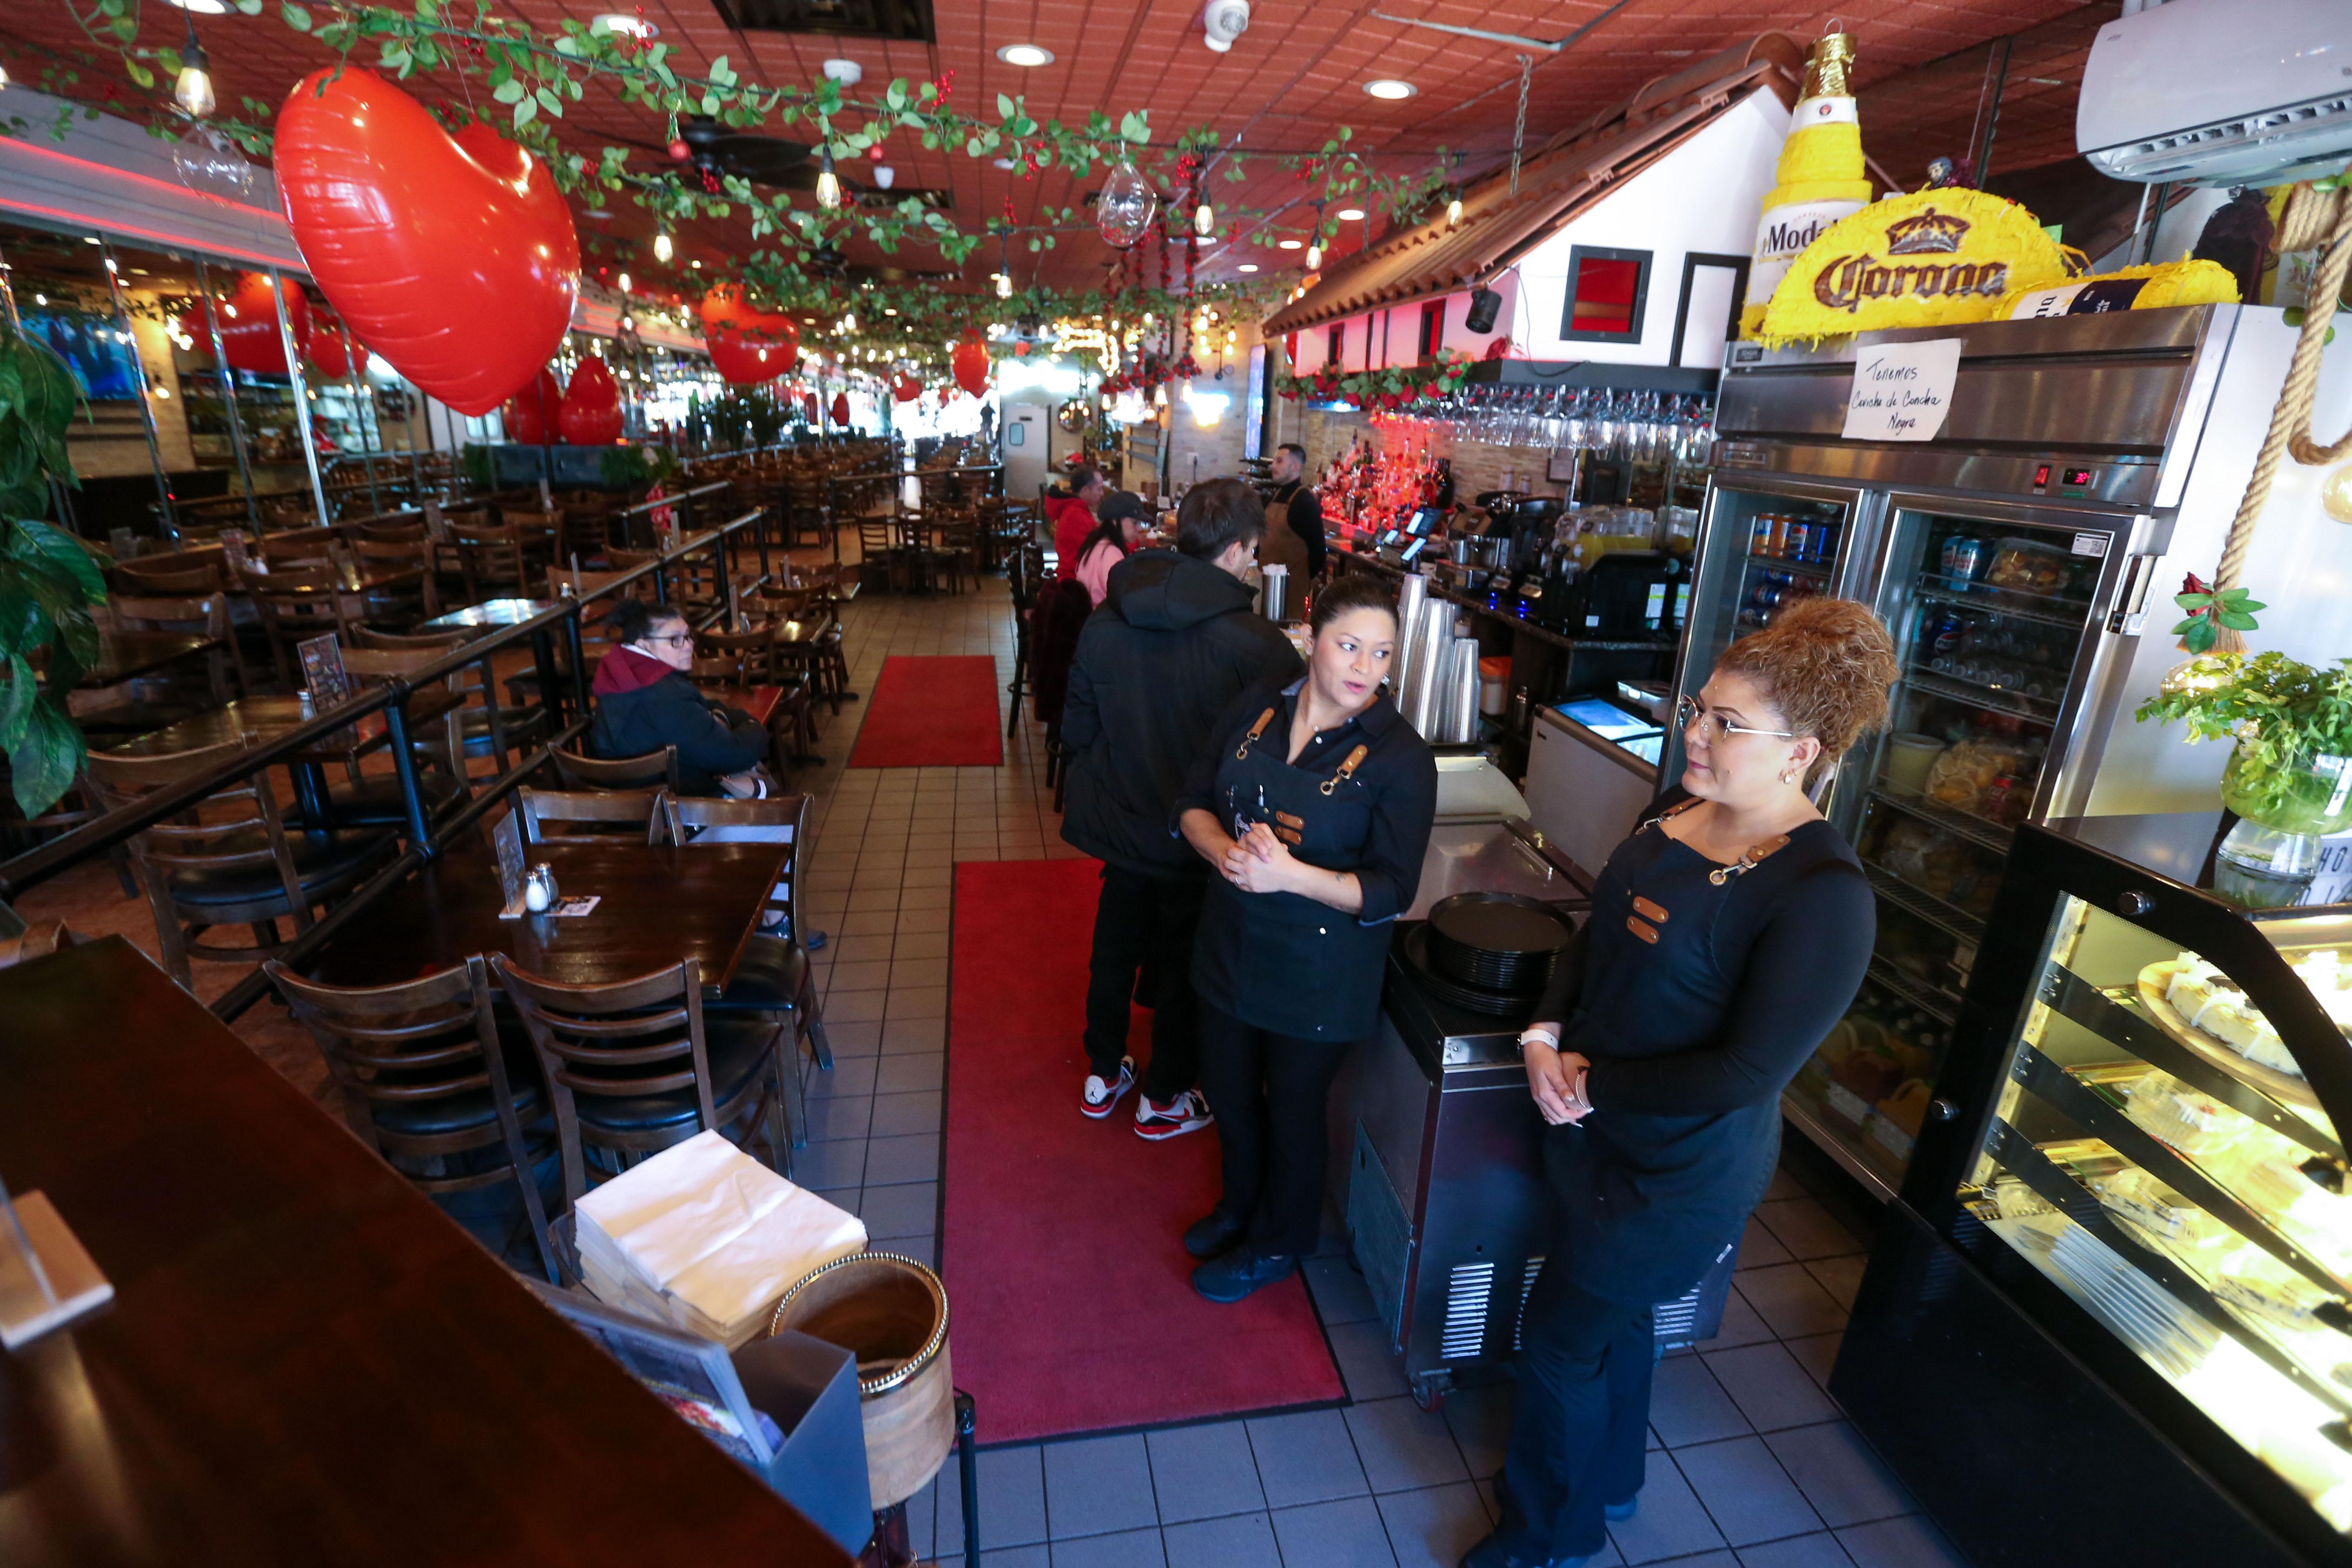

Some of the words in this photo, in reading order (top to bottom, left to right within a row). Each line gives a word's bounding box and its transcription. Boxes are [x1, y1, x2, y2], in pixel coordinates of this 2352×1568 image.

[1768, 218, 1837, 253] Mod
[1815, 253, 2007, 313] Corona
[1866, 357, 1917, 380] Tenemos
[1886, 391, 1897, 408] de
[1887, 412, 1916, 436] Negra
